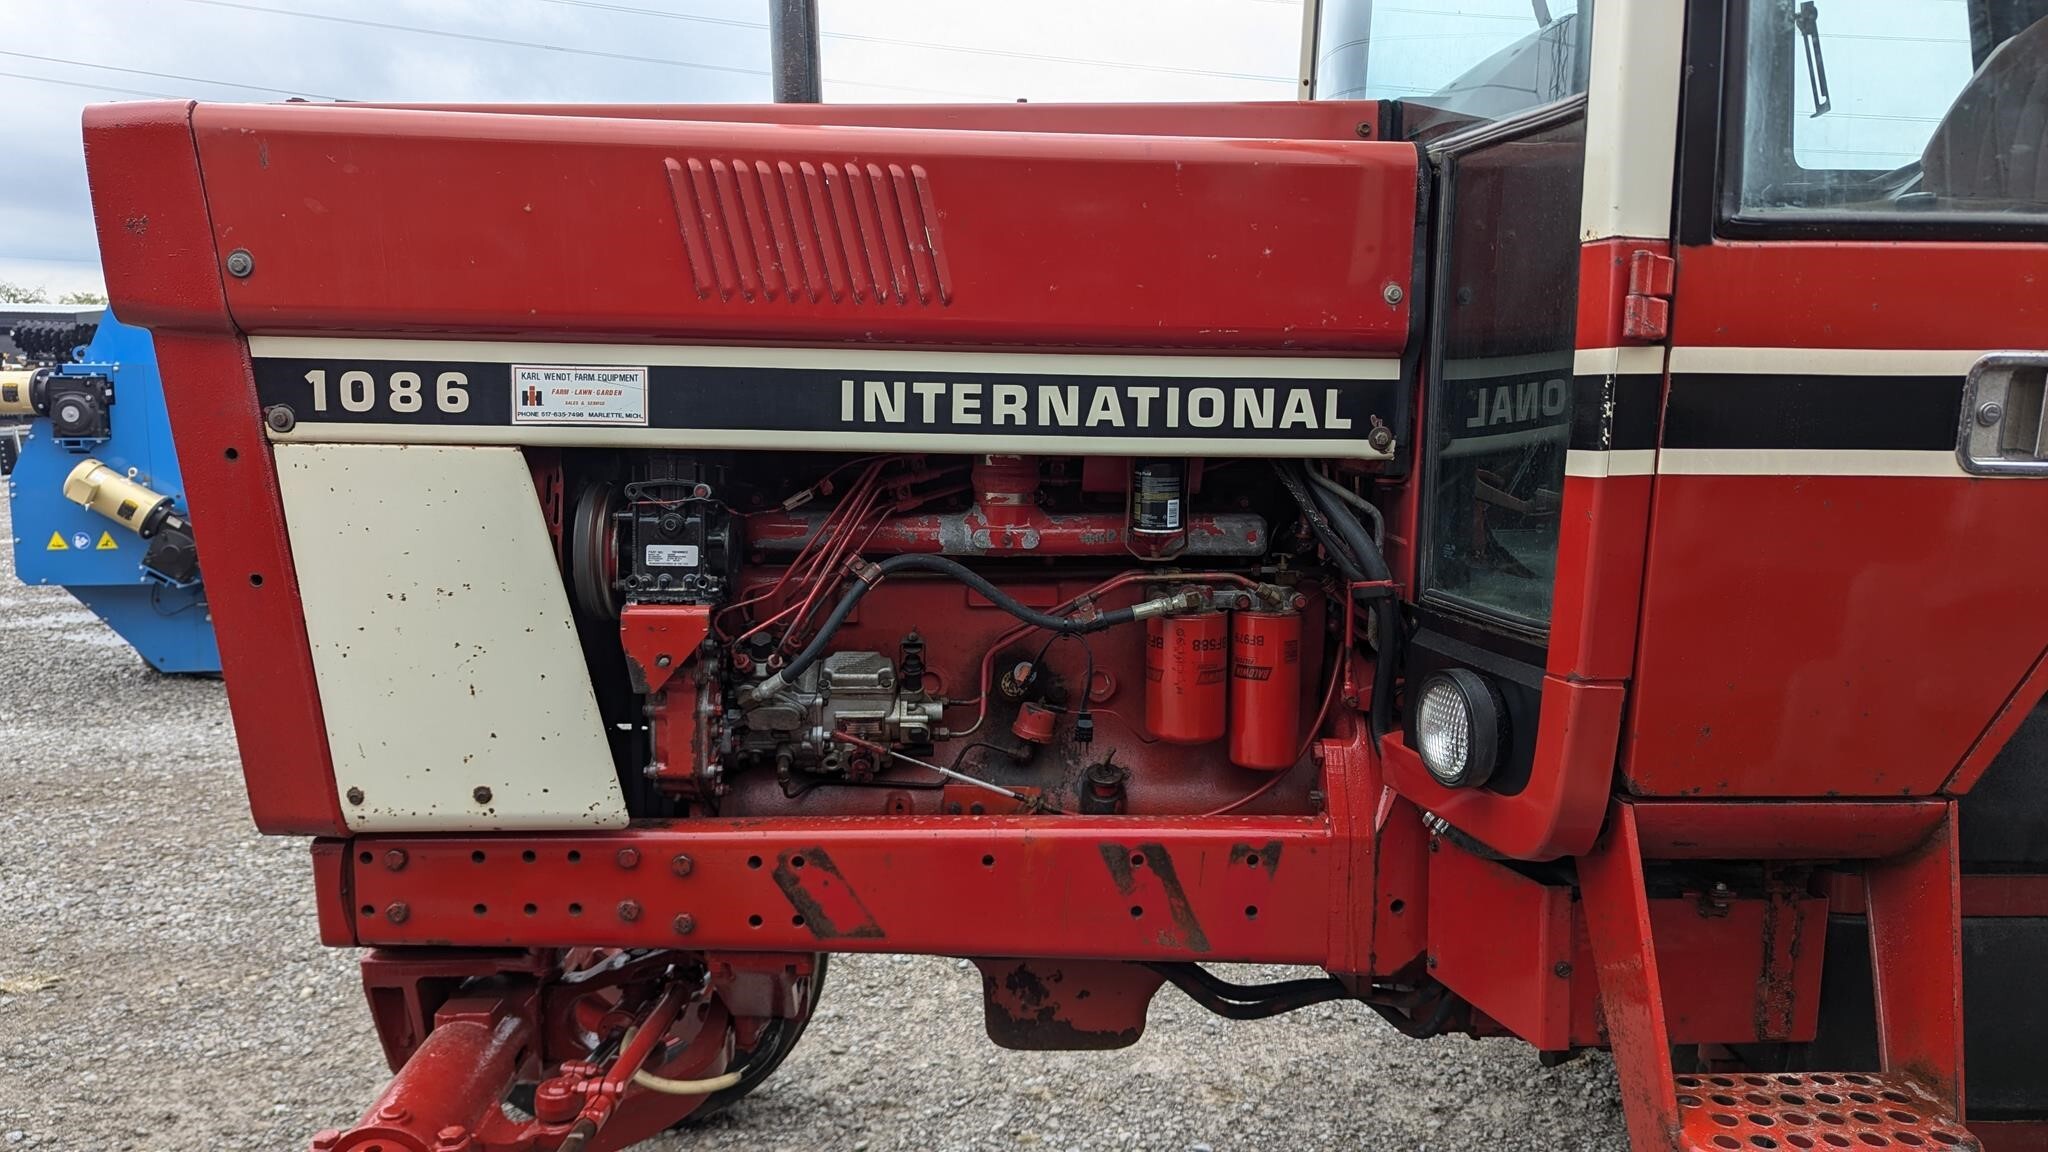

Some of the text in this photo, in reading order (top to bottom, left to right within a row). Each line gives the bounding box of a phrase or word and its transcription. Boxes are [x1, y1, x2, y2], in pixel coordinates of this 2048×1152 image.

[304, 369, 470, 413] 1086
[521, 372, 639, 382] KARL WENDT FARM EQUIPMENT
[841, 379, 1352, 430] INTERNATIONAL
